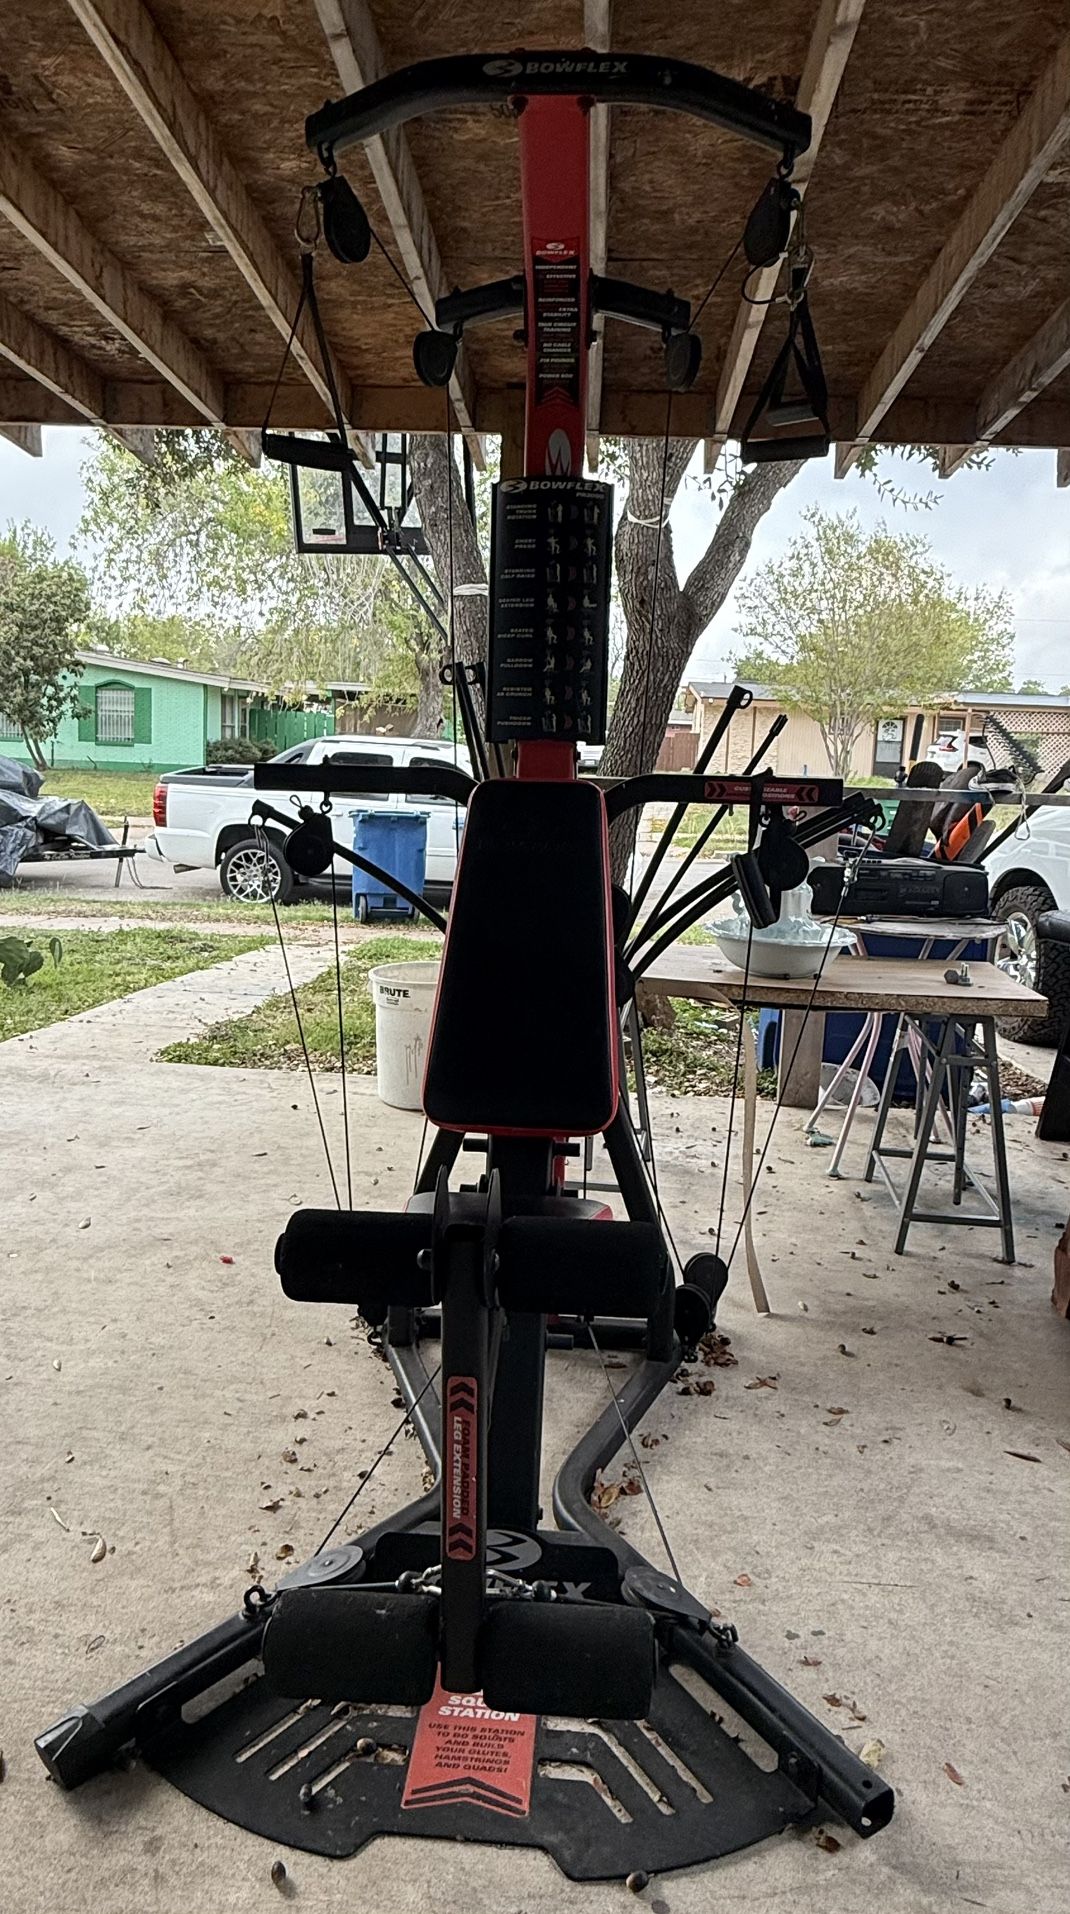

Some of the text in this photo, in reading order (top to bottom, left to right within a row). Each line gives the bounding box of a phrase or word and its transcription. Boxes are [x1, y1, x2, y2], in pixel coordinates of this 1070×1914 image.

[525, 61, 628, 74] BOWFLEX
[529, 481, 607, 492] BOWFLEX
[380, 986, 410, 998] BRUTE
[452, 1416, 462, 1519] LEG EXTENSION
[448, 1695, 487, 1708] SQU
[438, 1706, 520, 1721] STATION
[453, 1724, 477, 1732] THIS
[480, 1727, 525, 1736] STATION
[471, 1734, 515, 1743] SQUATS
[436, 1746, 466, 1754] YOUR
[434, 1754, 510, 1765] HAMSTRINGS
